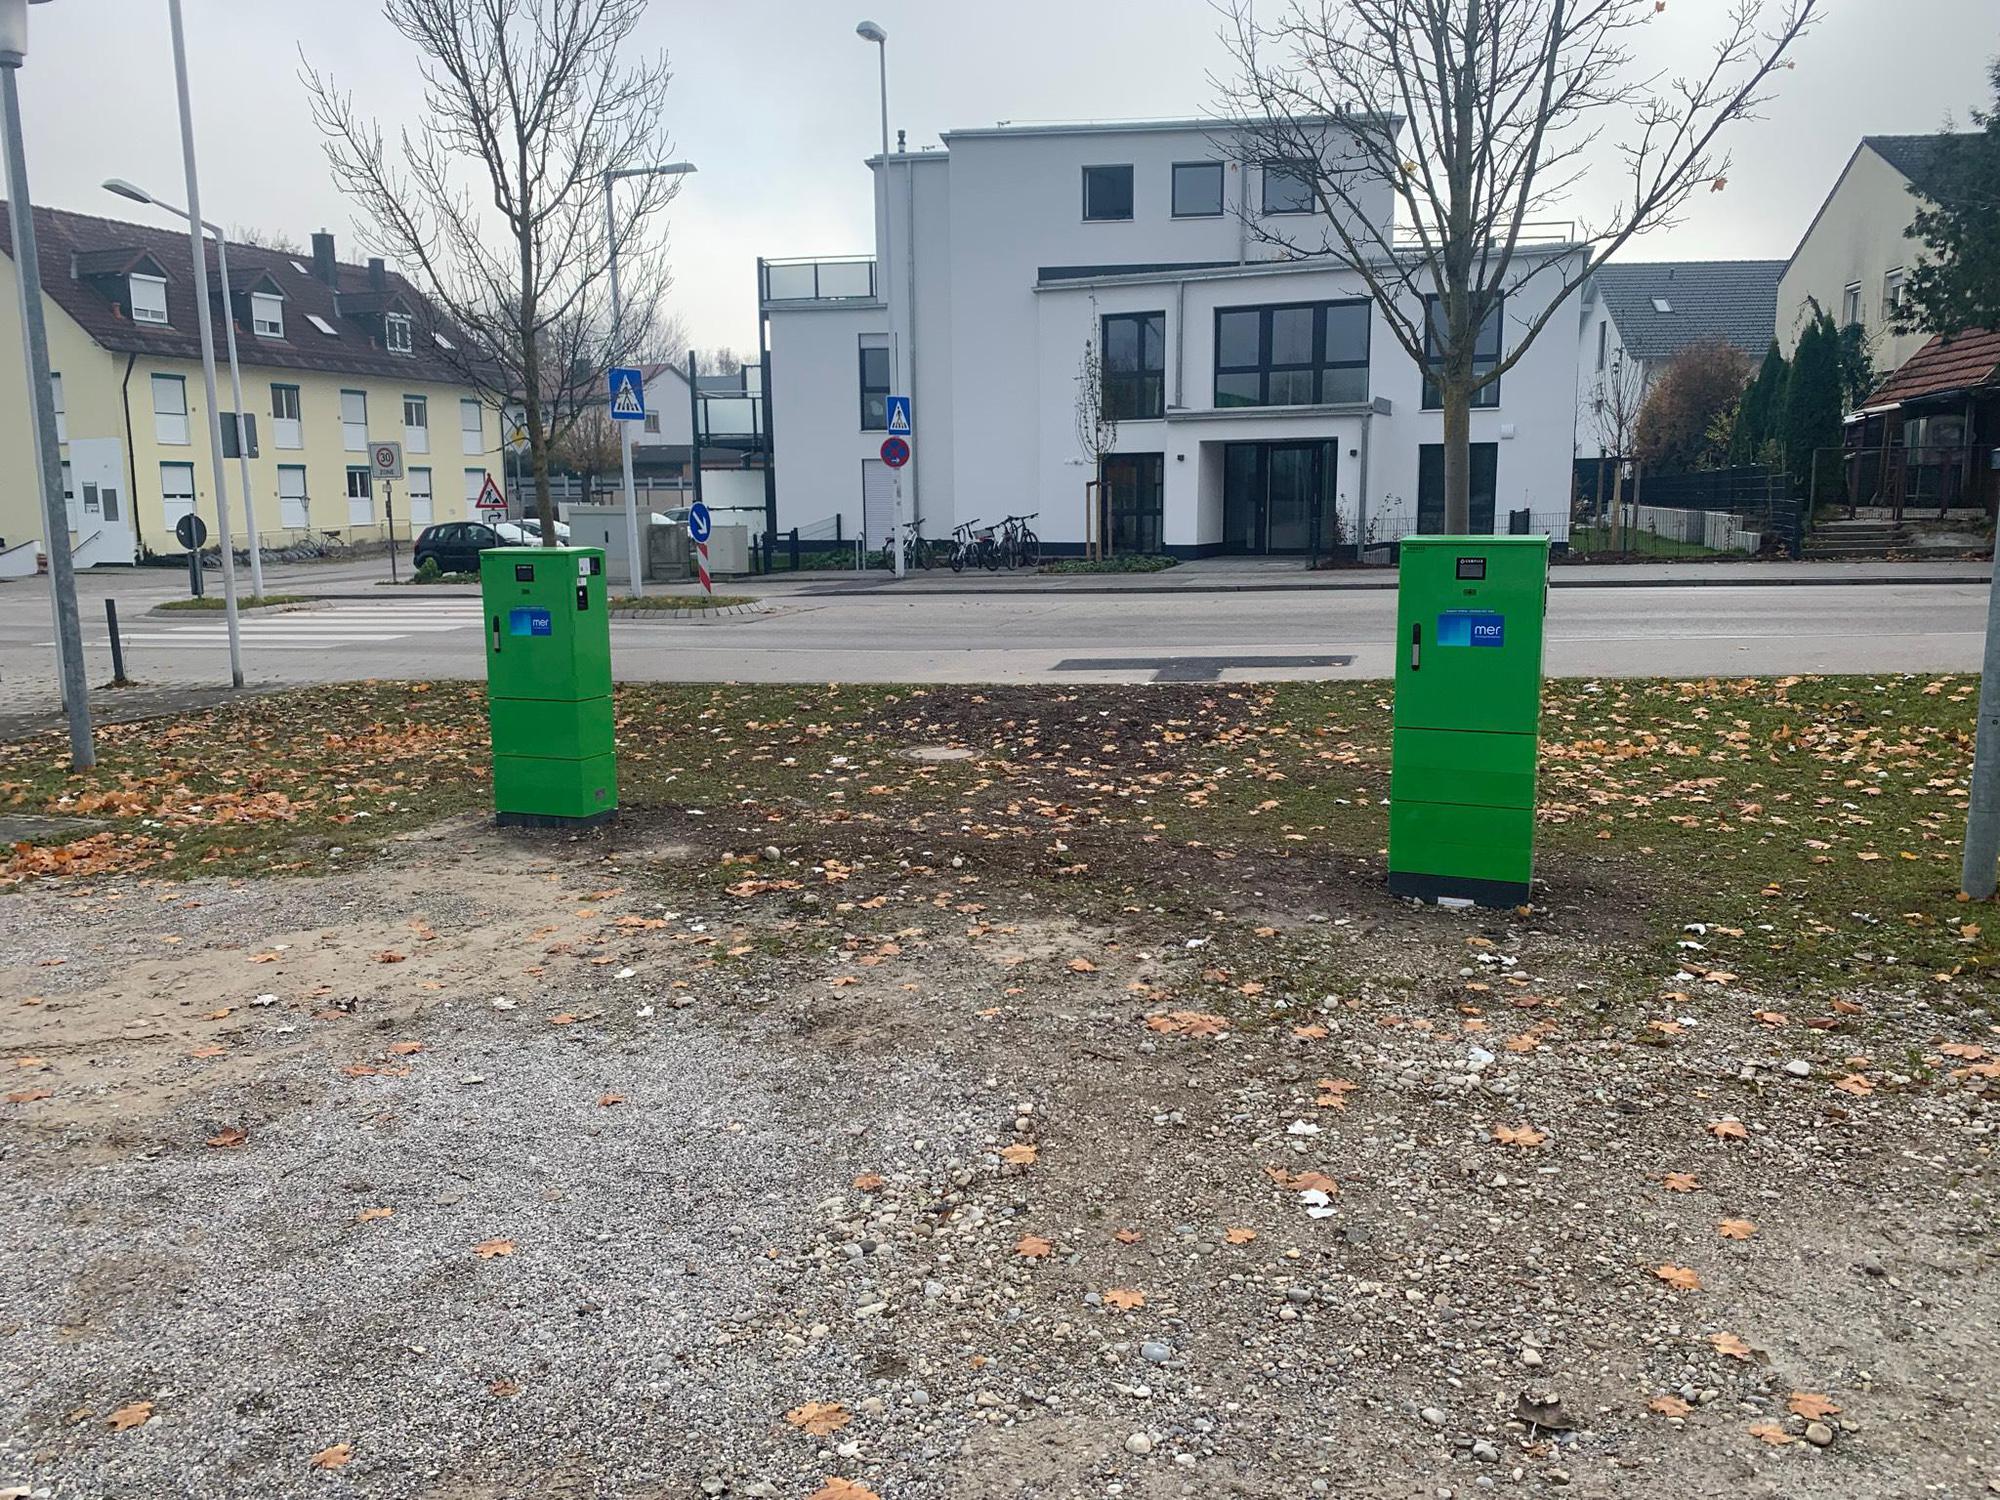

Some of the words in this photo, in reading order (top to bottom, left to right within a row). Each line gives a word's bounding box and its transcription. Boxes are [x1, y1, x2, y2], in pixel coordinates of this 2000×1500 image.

[380, 452, 390, 462] 30
[532, 618, 549, 627] mer
[1474, 625, 1501, 635] mer
